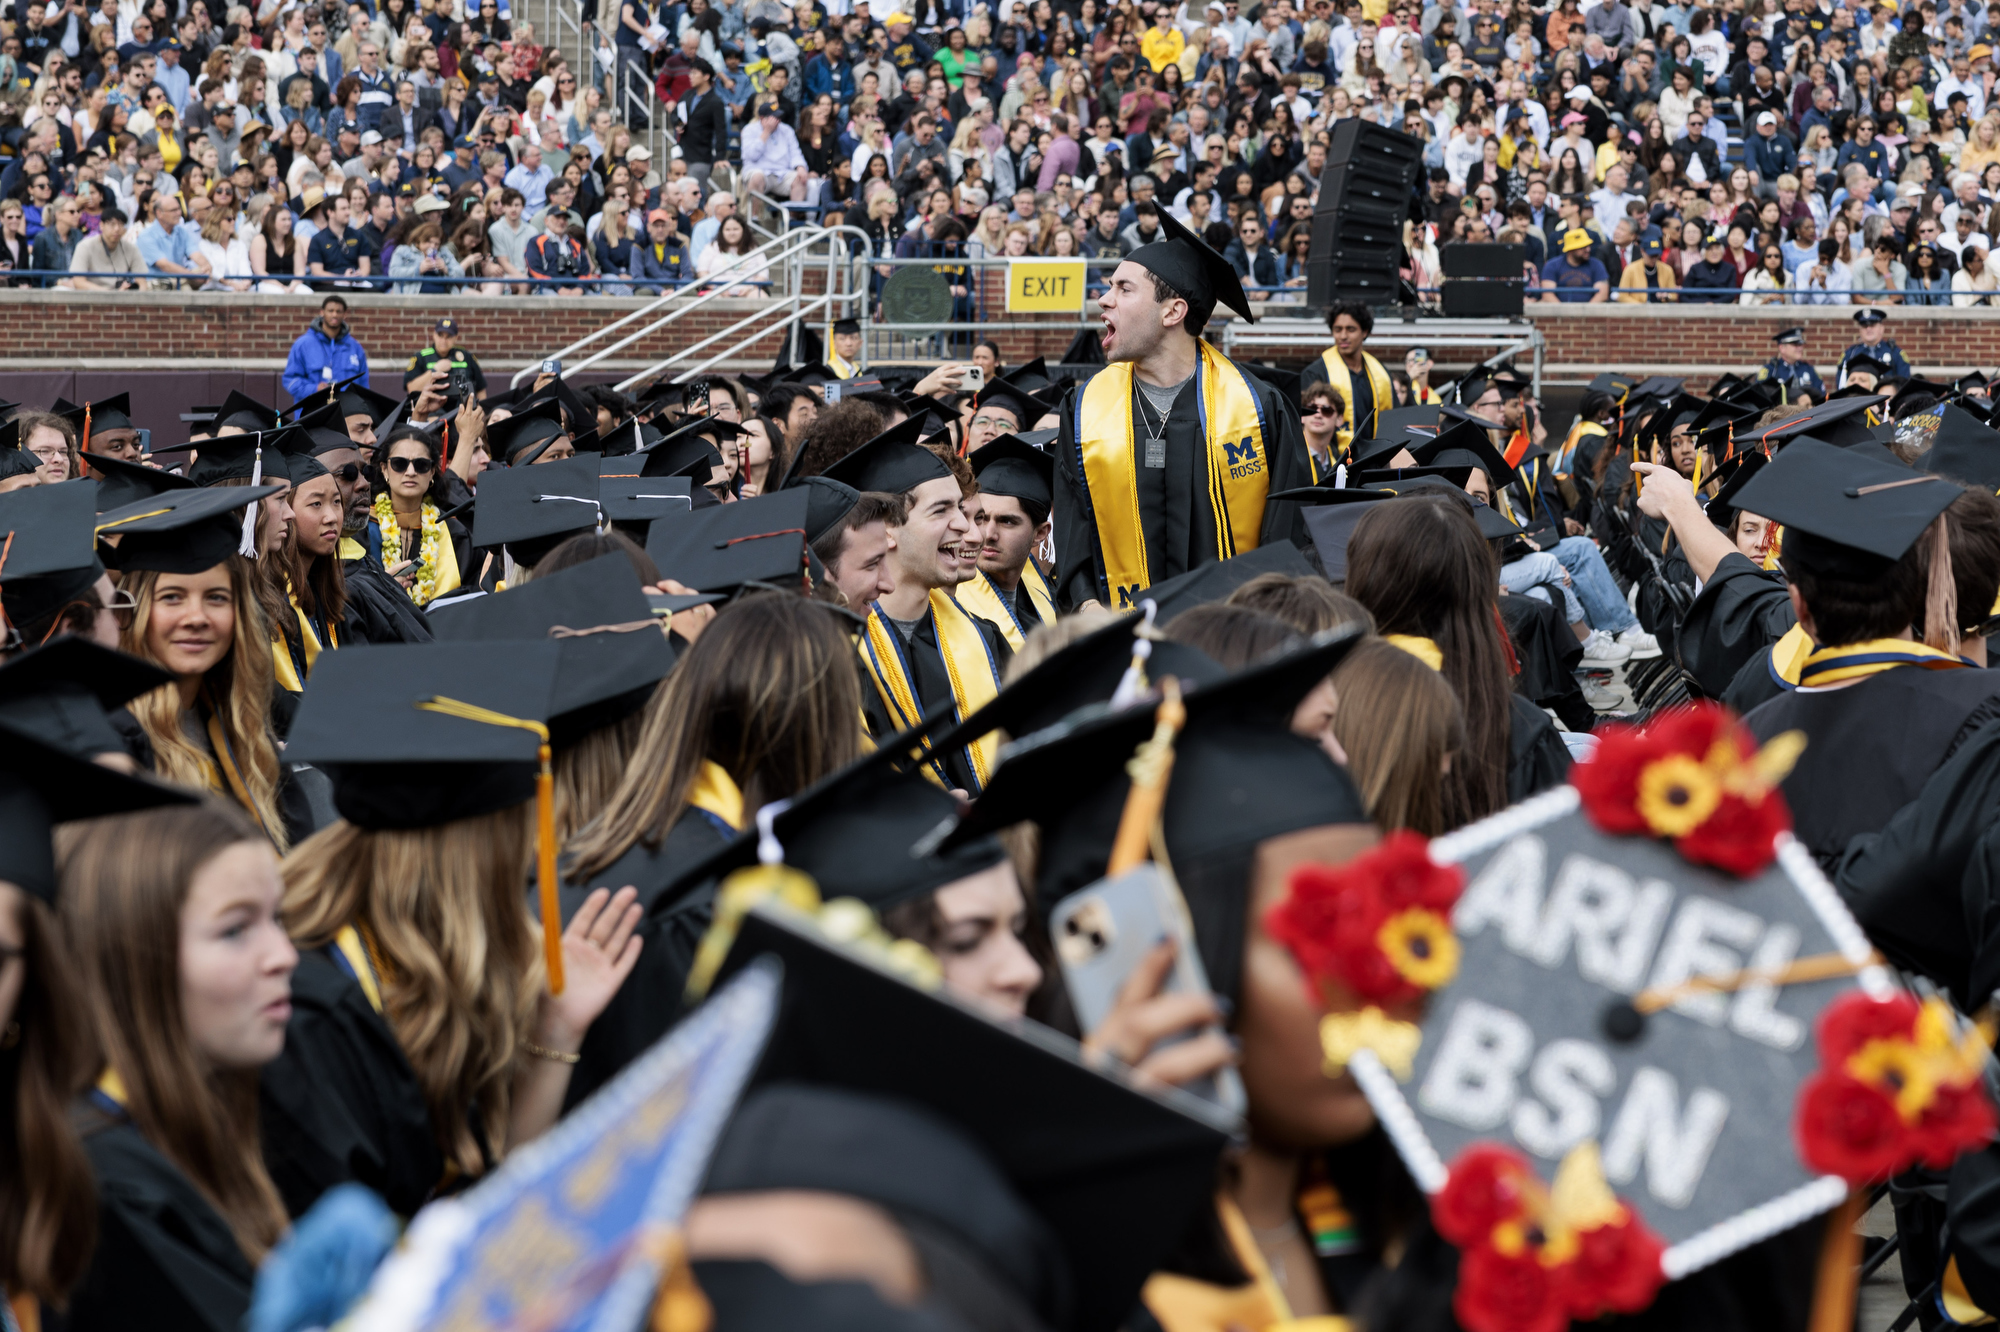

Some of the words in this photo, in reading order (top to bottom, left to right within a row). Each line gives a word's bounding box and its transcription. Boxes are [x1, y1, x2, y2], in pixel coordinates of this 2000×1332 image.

[1023, 276, 1071, 297] EXIT
[1222, 435, 1258, 467] M
[1230, 460, 1262, 480] ROSS
[1451, 831, 1807, 1053] ARIEL
[1416, 999, 1730, 1211] BSN
